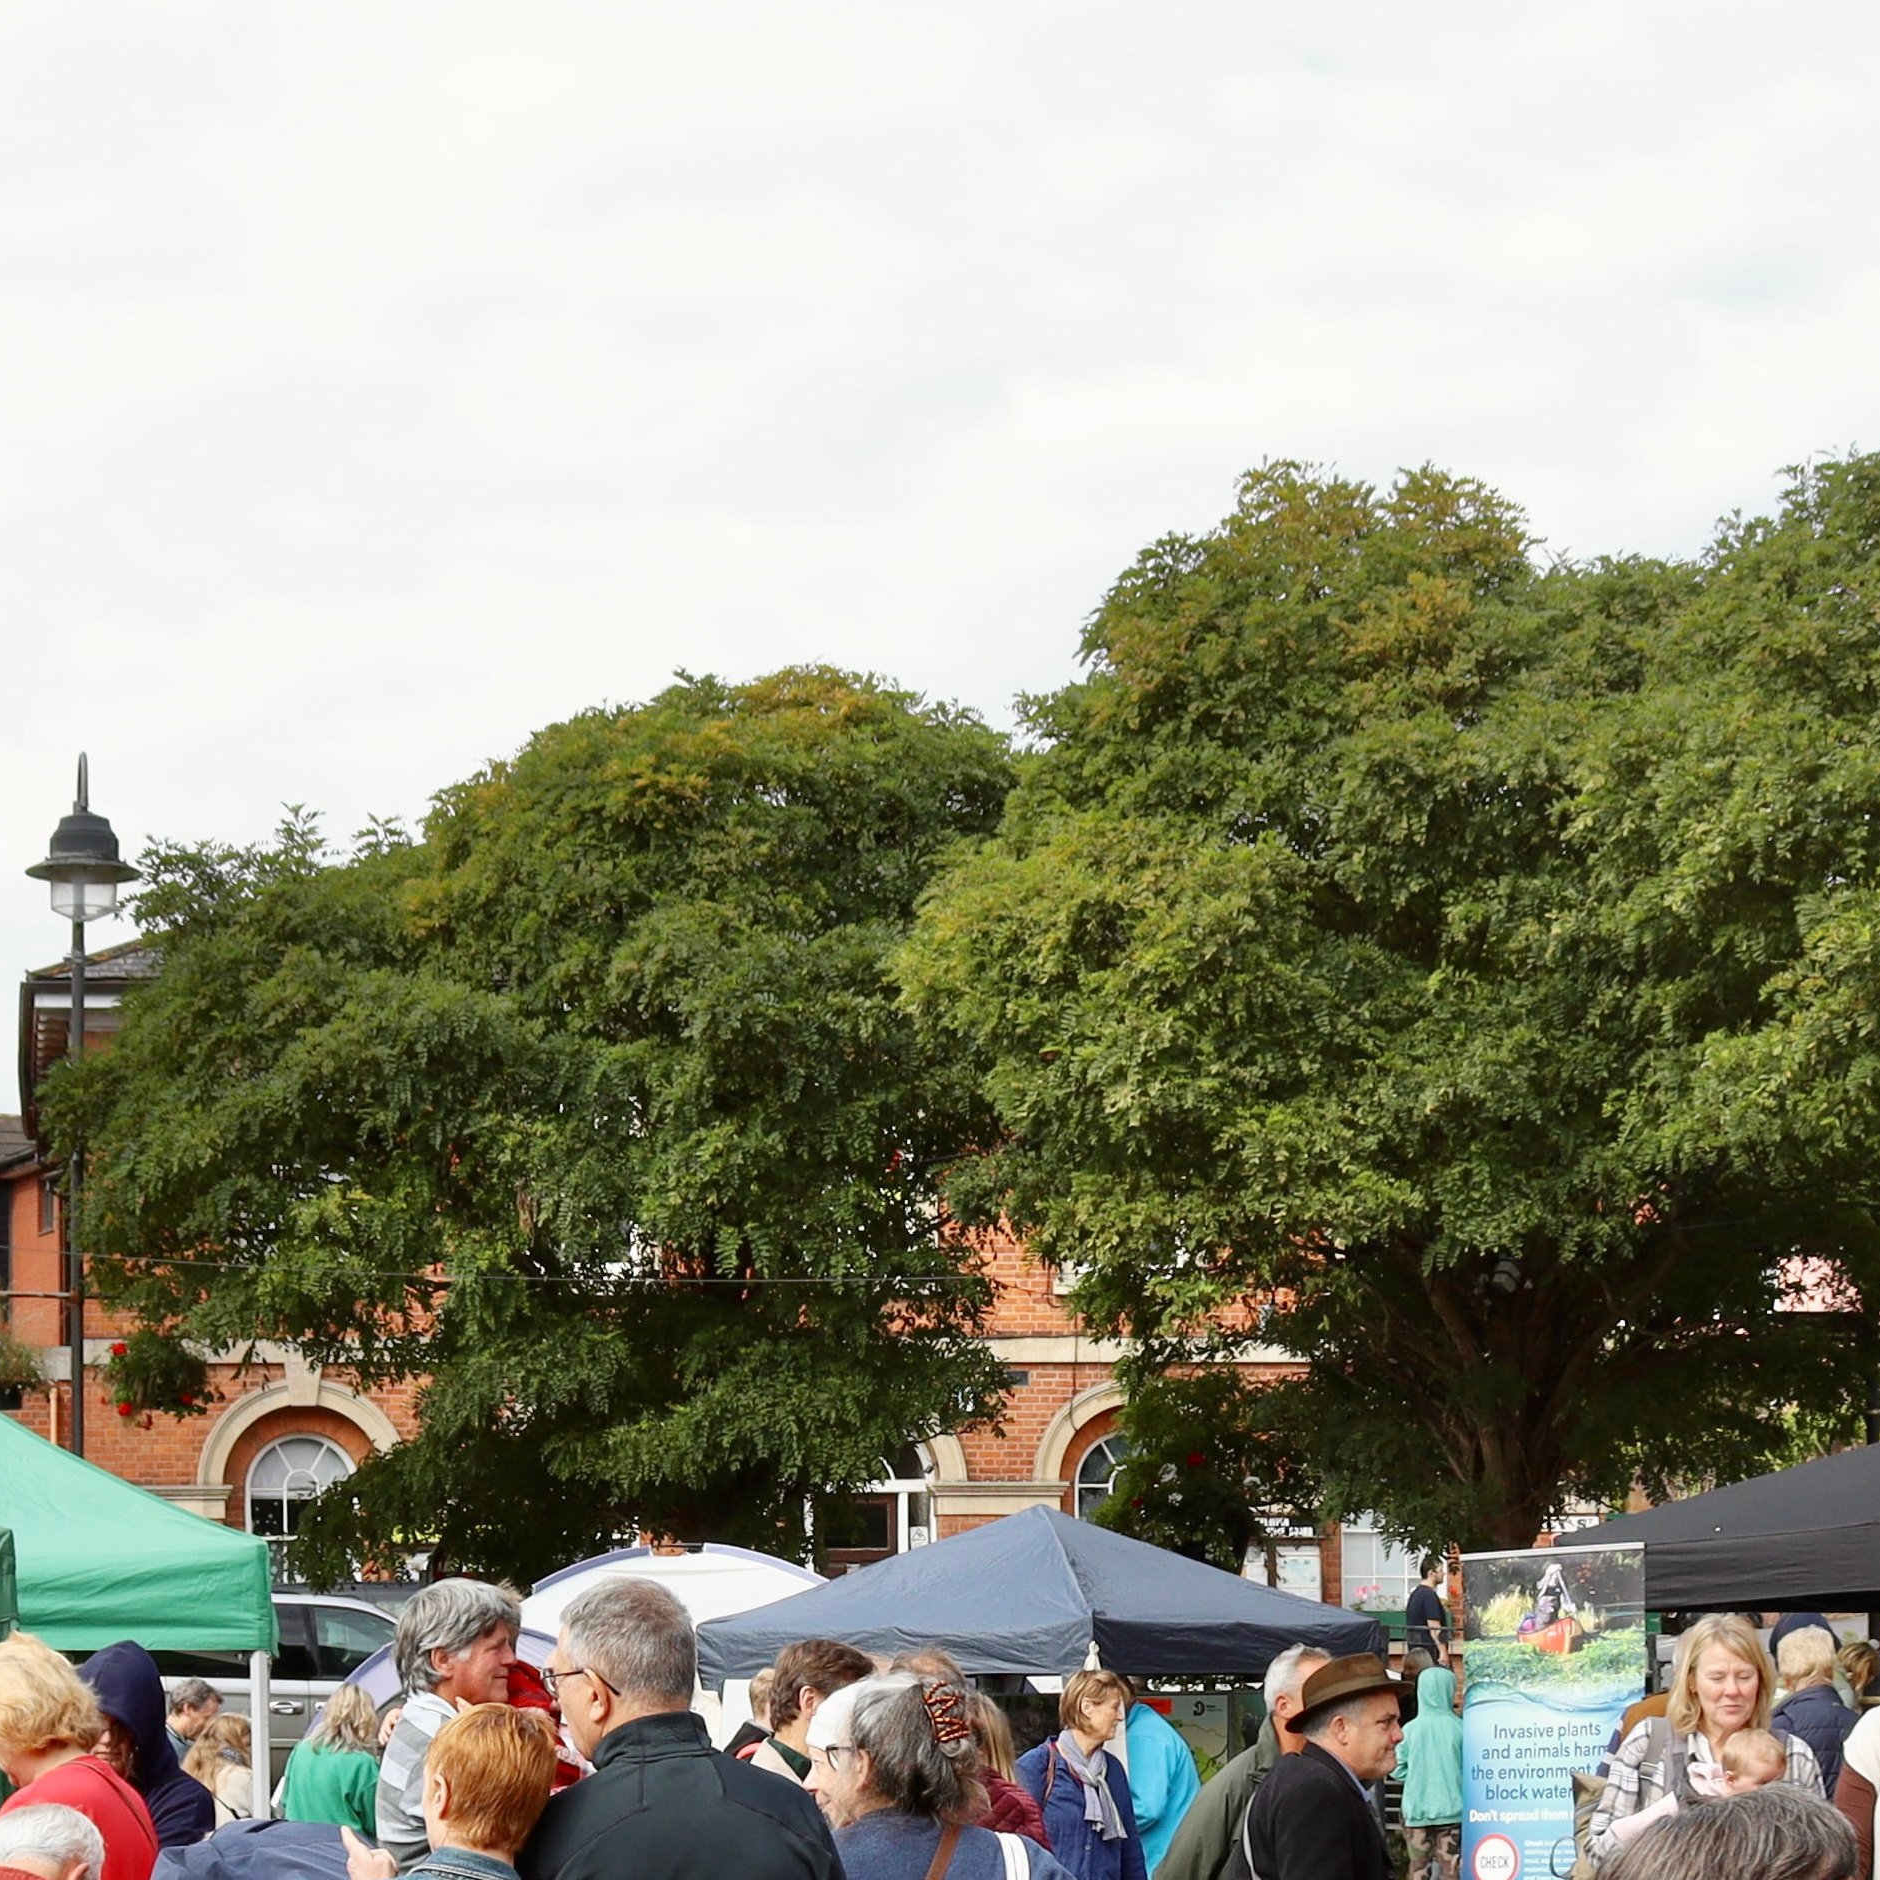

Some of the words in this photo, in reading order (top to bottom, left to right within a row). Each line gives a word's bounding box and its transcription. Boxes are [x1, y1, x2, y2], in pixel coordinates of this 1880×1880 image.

[1494, 1723, 1553, 1740] Invasive
[1557, 1722, 1602, 1740] plants
[1482, 1744, 1511, 1760] and
[1515, 1742, 1571, 1759] animals
[1471, 1765, 1494, 1780] the
[1498, 1763, 1591, 1780] environment
[1485, 1783, 1528, 1800] block
[1469, 1809, 1499, 1823] Don't
[1500, 1809, 1540, 1825] spread
[1541, 1808, 1568, 1822] them
[1479, 1856, 1510, 1869] CHECK
